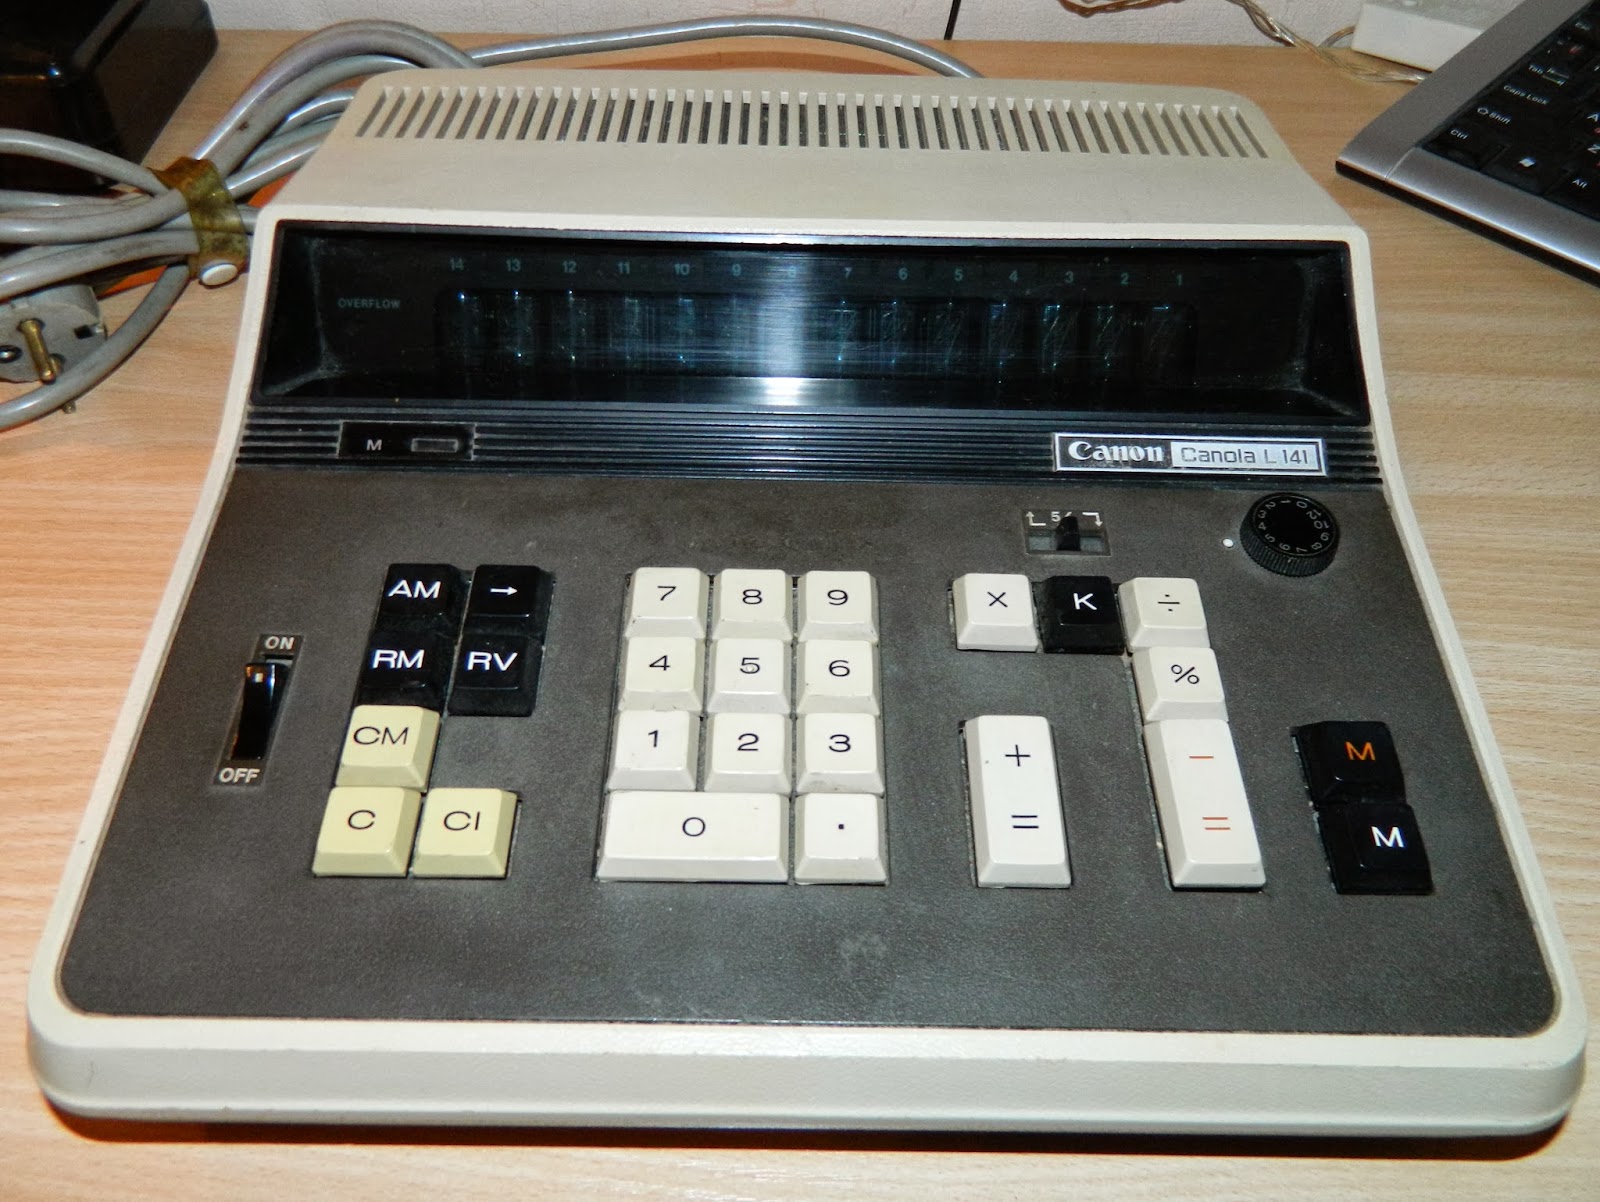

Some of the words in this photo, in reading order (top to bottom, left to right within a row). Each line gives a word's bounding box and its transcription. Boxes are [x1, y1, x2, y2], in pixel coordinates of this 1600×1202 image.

[1503, 84, 1526, 97] Caps
[1526, 93, 1549, 105] Lock
[1450, 129, 1468, 140] Ctrl
[450, 258, 464, 271] 14
[506, 259, 521, 272] 13
[562, 260, 577, 273] 12
[618, 262, 630, 275] 11
[674, 263, 690, 276] 10
[732, 264, 741, 277] 9
[844, 266, 853, 279] 7
[898, 267, 908, 281] 6
[954, 268, 963, 282] 5
[1009, 269, 1019, 283] 4
[1065, 270, 1075, 284] 3
[1120, 272, 1130, 285] 2
[337, 298, 400, 310] OVERFLOW
[366, 439, 382, 451] M
[1068, 440, 1165, 463] Canon
[1180, 446, 1256, 464] Canola
[388, 579, 441, 599] AM
[657, 585, 677, 601] 7
[742, 588, 763, 605] 8
[827, 589, 849, 606] 9
[1073, 592, 1098, 611] K
[264, 636, 294, 650] ON
[372, 649, 425, 669] RM
[466, 651, 518, 671] RV
[649, 655, 671, 672] 4
[739, 657, 761, 675] 5
[828, 660, 851, 678] 6
[1170, 664, 1200, 685] %
[353, 726, 409, 746] CM
[647, 730, 660, 748] 1
[737, 733, 760, 752] 2
[828, 734, 851, 753] 3
[1343, 741, 1376, 761] M
[218, 767, 261, 783] OFF
[347, 809, 376, 830] C
[443, 811, 480, 831] CI
[1371, 826, 1405, 848] M
